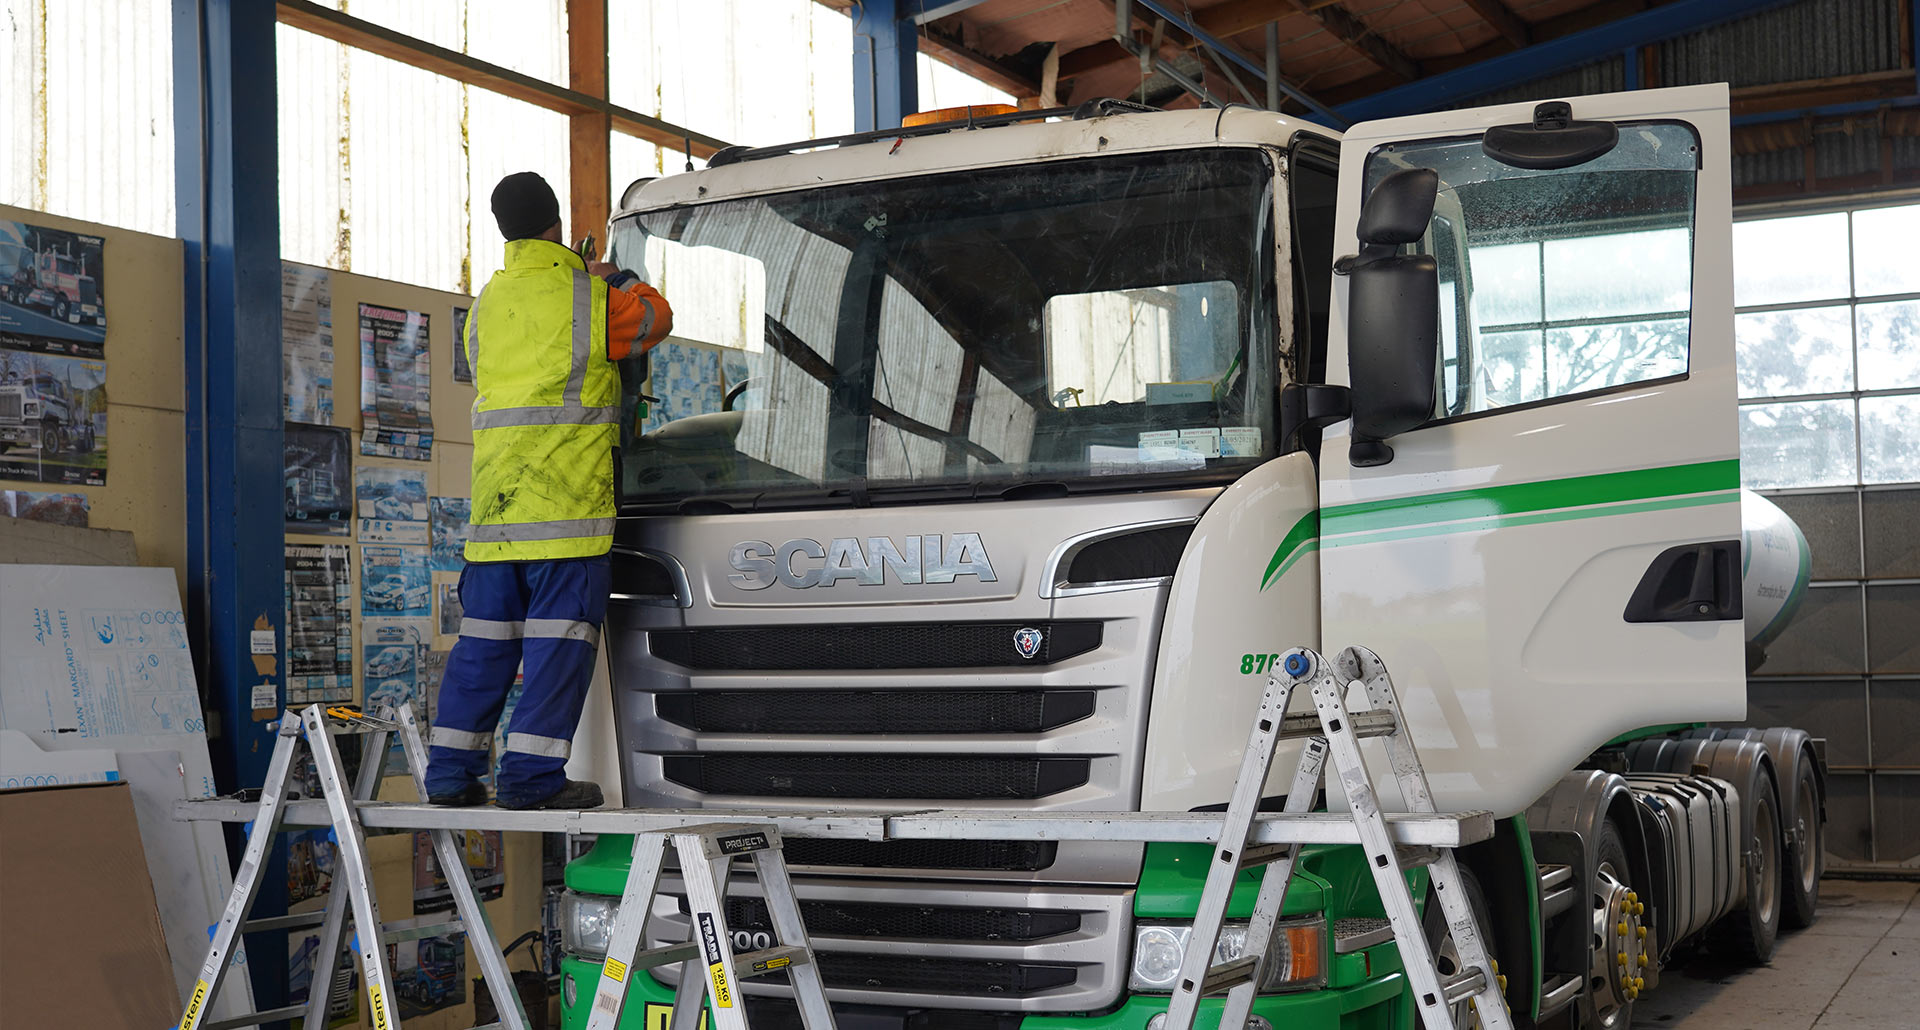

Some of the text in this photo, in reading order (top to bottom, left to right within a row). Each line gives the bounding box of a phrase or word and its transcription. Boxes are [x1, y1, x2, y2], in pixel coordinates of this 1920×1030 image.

[728, 532, 998, 591] SCANIA
[58, 609, 70, 639] SHEET
[725, 836, 761, 849] PROJECT
[702, 916, 719, 962] TRADE
[716, 968, 729, 1002] 120 KG
[374, 993, 386, 1030] tem
